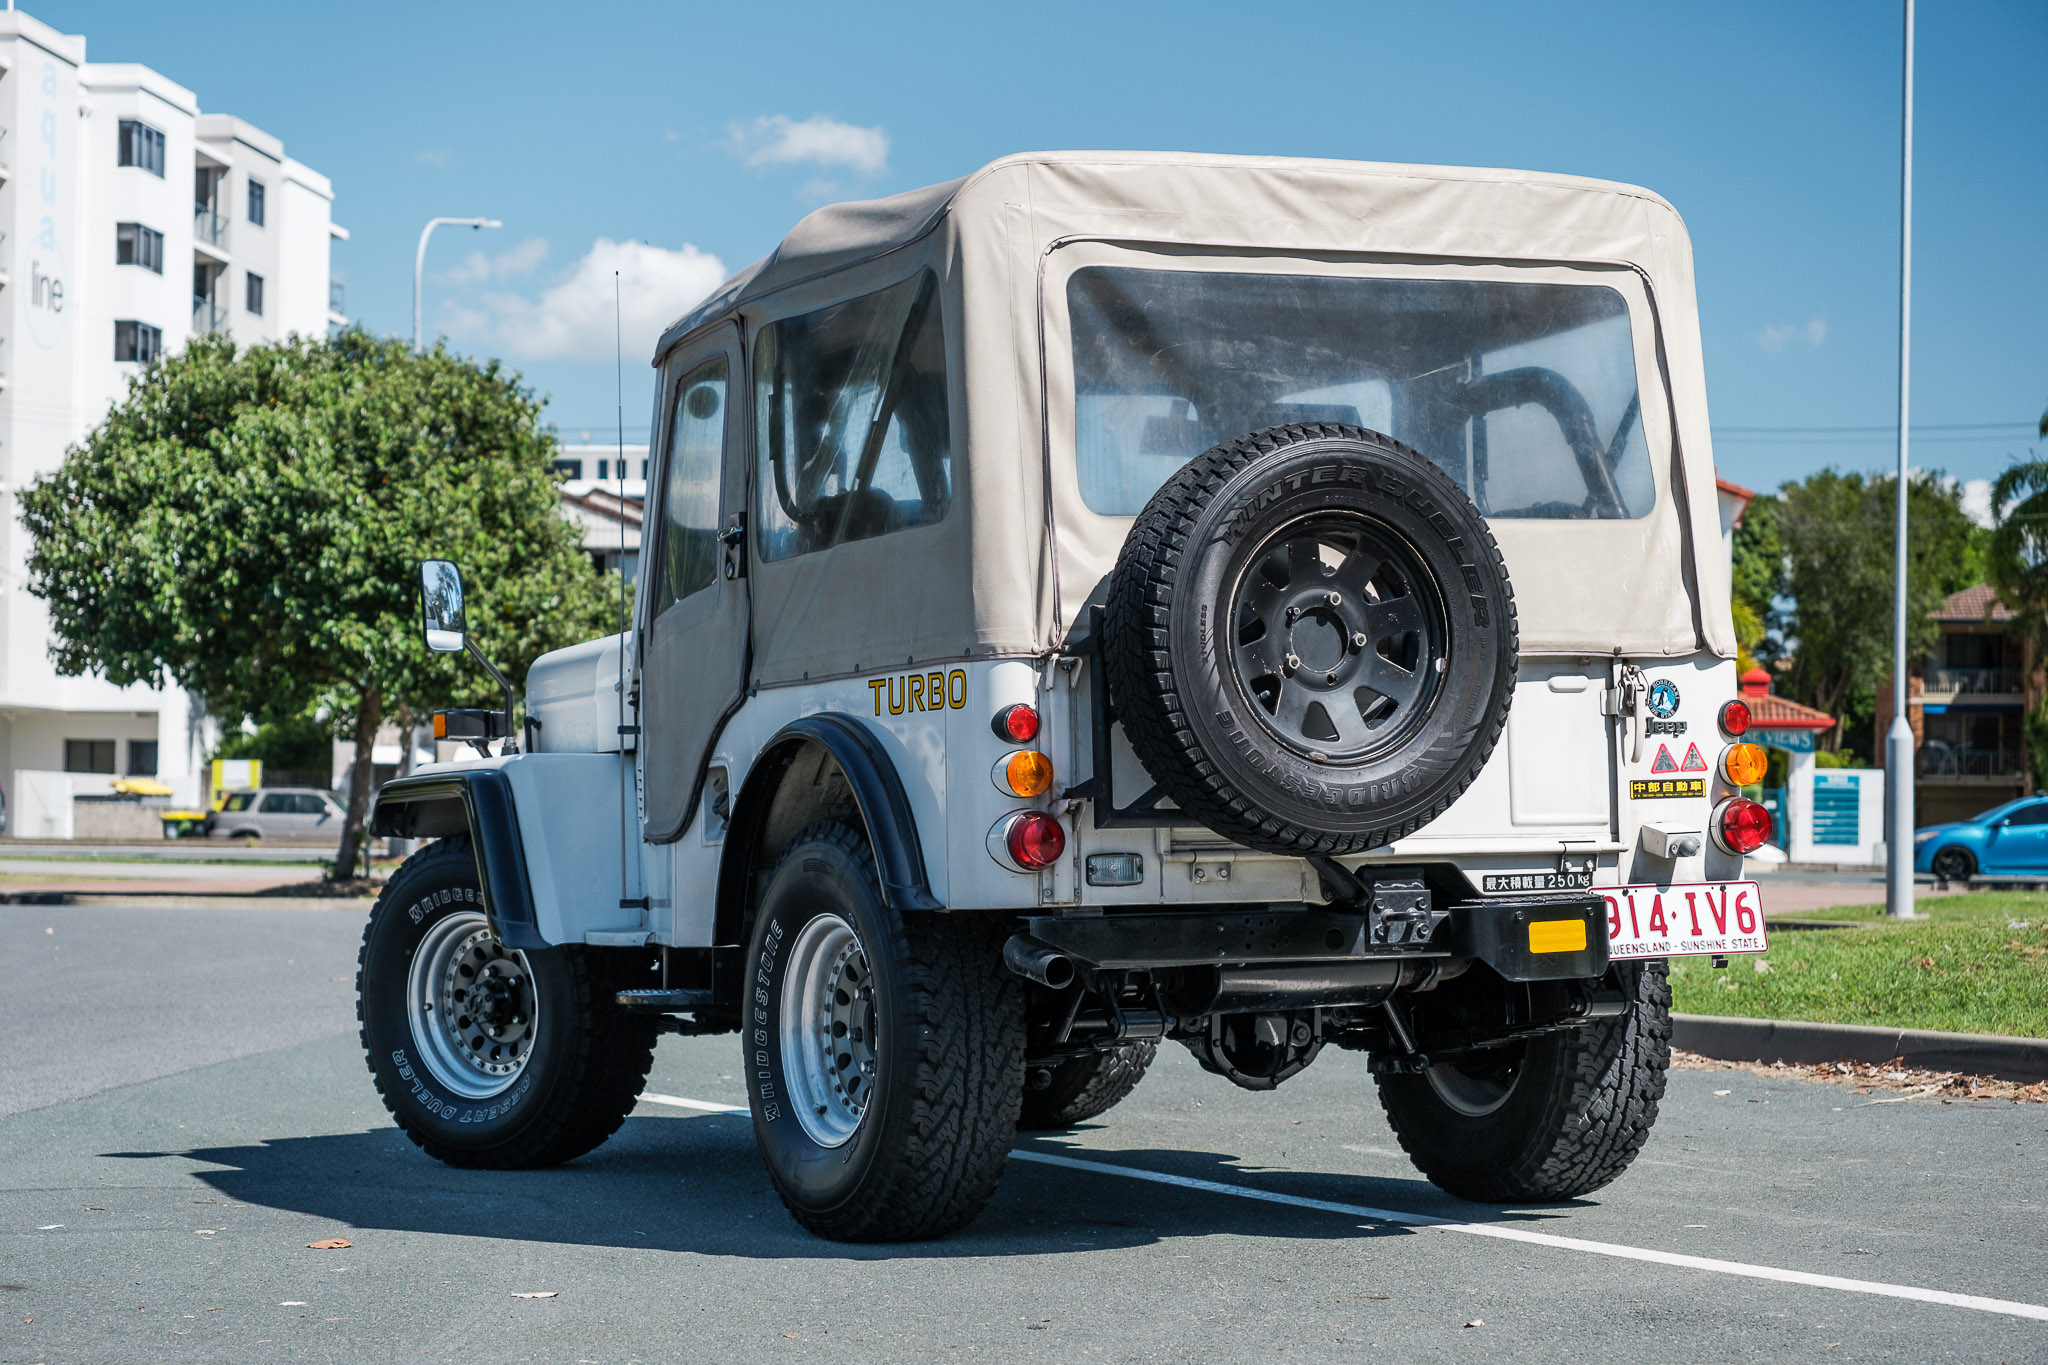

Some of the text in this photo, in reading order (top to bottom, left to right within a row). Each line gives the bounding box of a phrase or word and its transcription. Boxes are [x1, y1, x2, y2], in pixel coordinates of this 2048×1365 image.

[32, 258, 63, 313] line
[1223, 465, 1369, 546] WINTER
[868, 668, 967, 716] TURBO
[1645, 717, 1687, 738] Jeep
[1766, 728, 1811, 748] VIEWS
[1215, 710, 1423, 806] BRIDGESTONE
[1633, 781, 1702, 793] 中部自動車
[408, 887, 484, 925] BRIDGES
[1680, 939, 1727, 951] SUNSHINE
[1732, 937, 1759, 949] STATE
[754, 919, 783, 1122] BRIDGESTONE
[392, 1049, 531, 1123] DESERT DUELER
